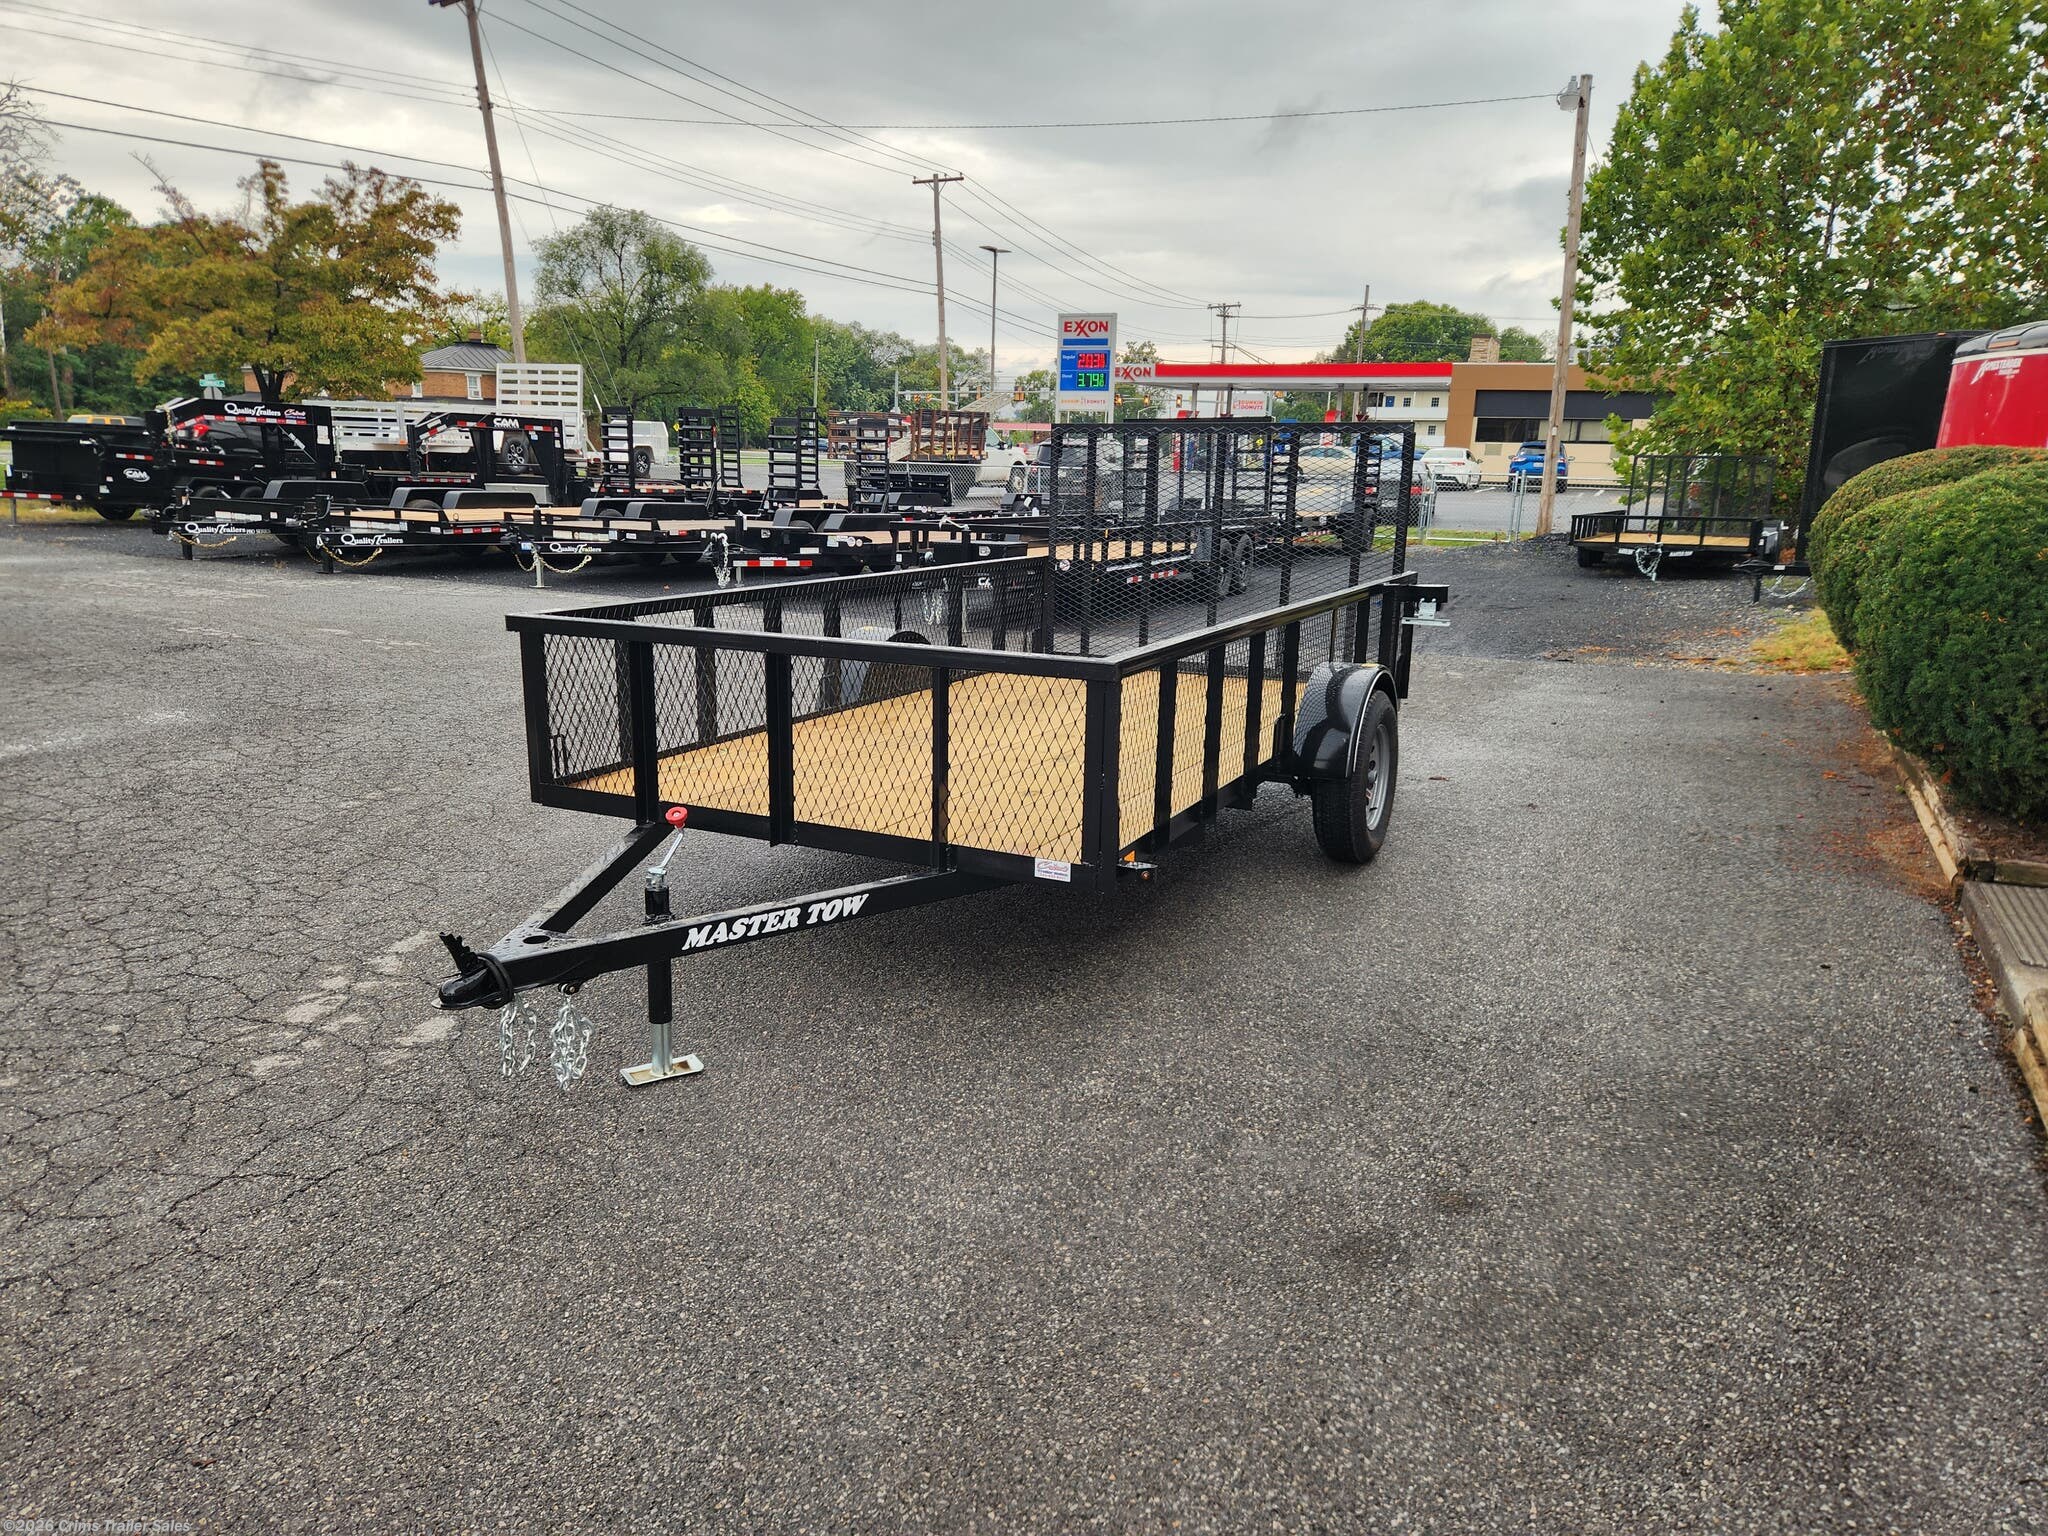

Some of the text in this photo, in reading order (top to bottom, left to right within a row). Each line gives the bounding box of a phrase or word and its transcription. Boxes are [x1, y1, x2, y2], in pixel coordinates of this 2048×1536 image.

[1063, 320, 1108, 337] EXXON
[1115, 366, 1151, 381] EXXON
[682, 894, 869, 950] MASTER TOW
